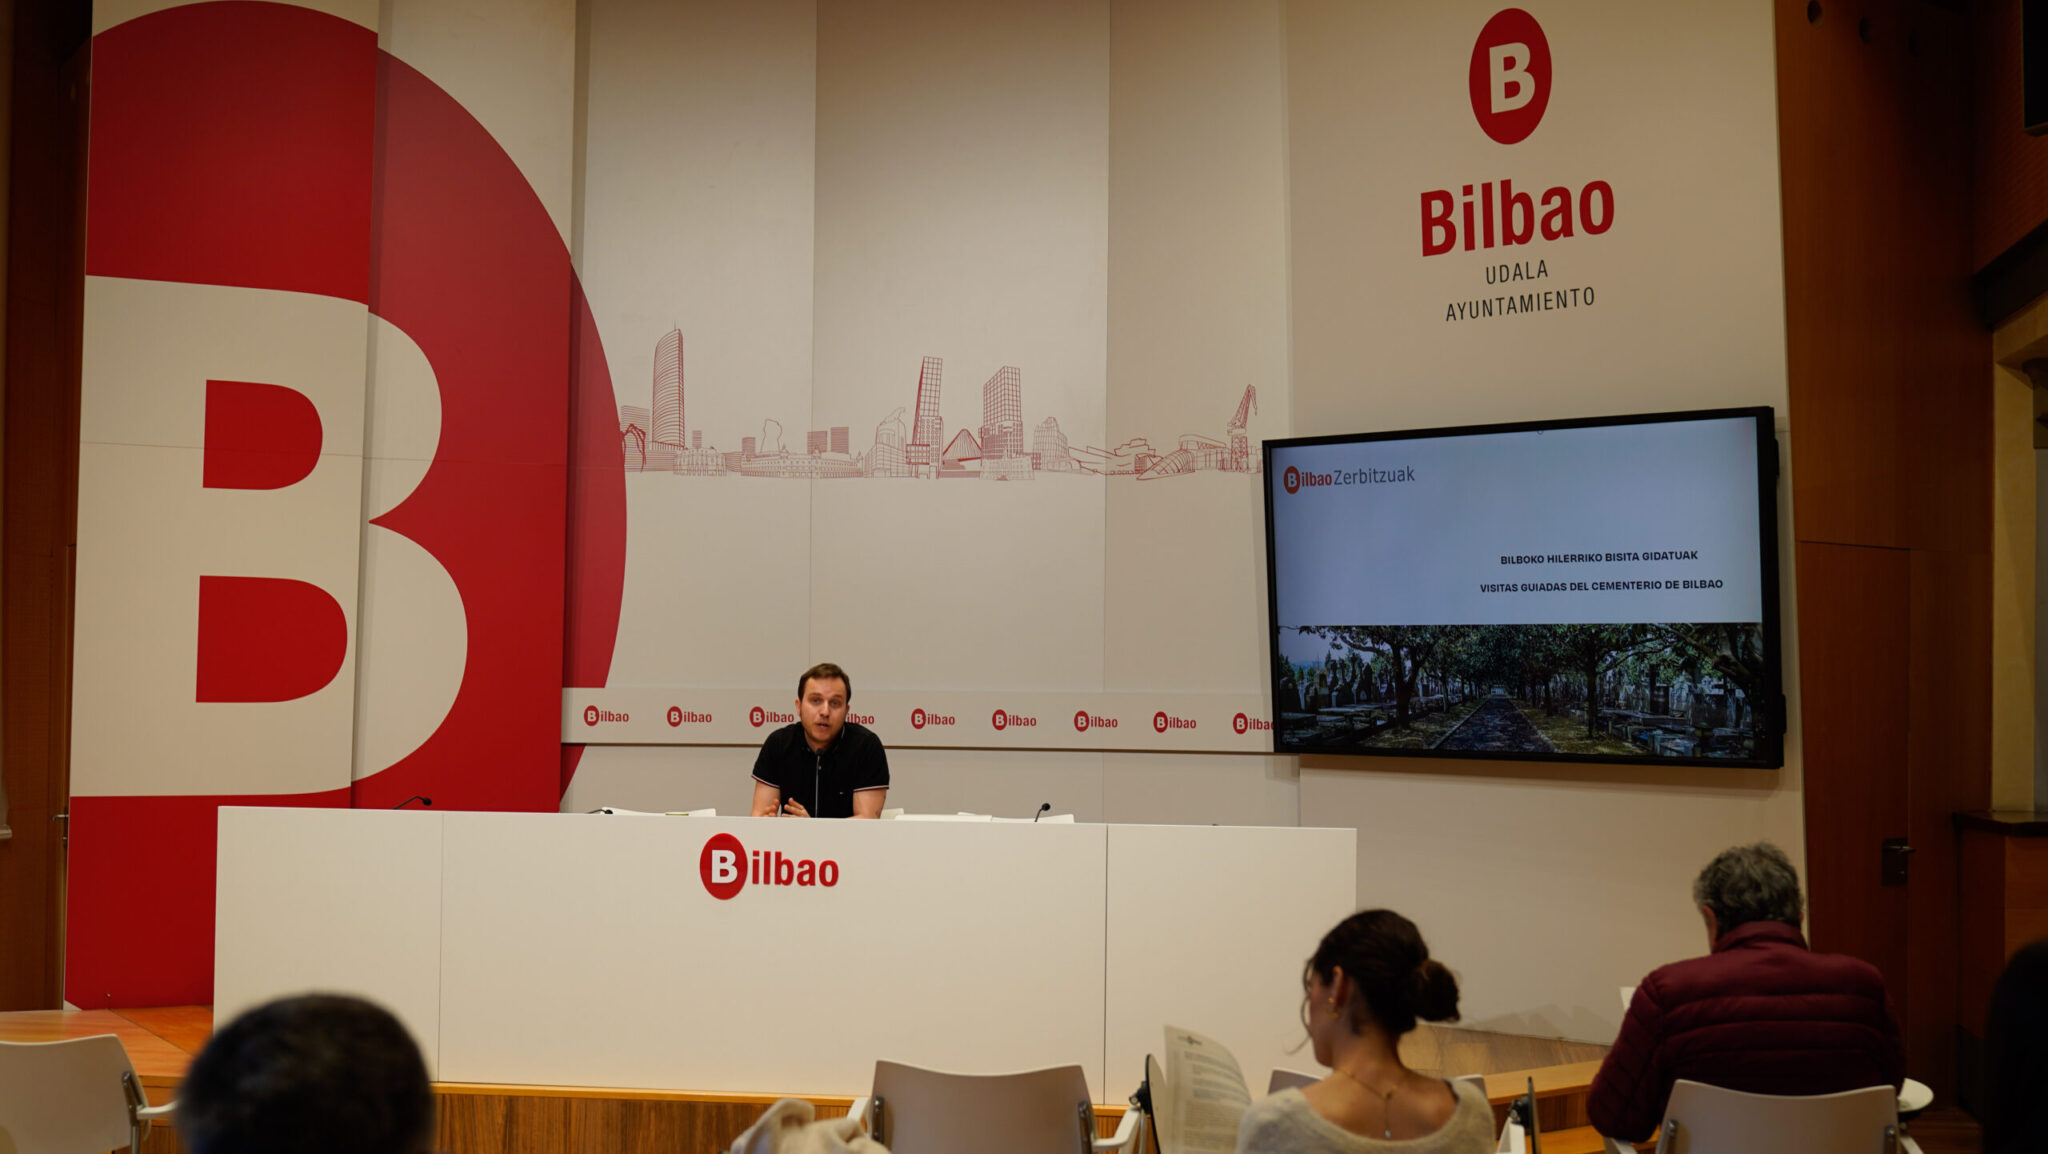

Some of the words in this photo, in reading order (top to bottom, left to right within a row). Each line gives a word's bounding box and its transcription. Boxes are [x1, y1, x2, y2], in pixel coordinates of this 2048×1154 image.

[1489, 42, 1535, 114] B
[1420, 179, 1615, 257] Bilbao
[1485, 259, 1548, 285] UDALA
[1446, 286, 1595, 322] AYUNTAMIENTO
[70, 275, 468, 798] B
[1500, 555, 1544, 565] BILBOKO
[1547, 553, 1603, 563] HILERRIKO
[1605, 552, 1640, 562] BISITA
[1642, 551, 1698, 561] GIDATUAK
[1480, 583, 1518, 593] VISITAS
[1520, 582, 1567, 592] GUIADAS
[1569, 581, 1589, 592] DEL
[1591, 581, 1662, 591] CEMENTERIO
[1665, 580, 1680, 590] DE
[1682, 579, 1724, 590] BILBAO
[586, 709, 630, 723] Bilbao
[668, 710, 712, 724] Bilbao
[752, 711, 795, 724] Bilbao
[846, 713, 875, 725] ilbao
[914, 712, 956, 726] Bilbao
[995, 713, 1037, 727] Bilbao
[1077, 715, 1119, 729] Bilbao
[1156, 716, 1197, 729] Bilbao
[709, 847, 840, 889] Bilbao
